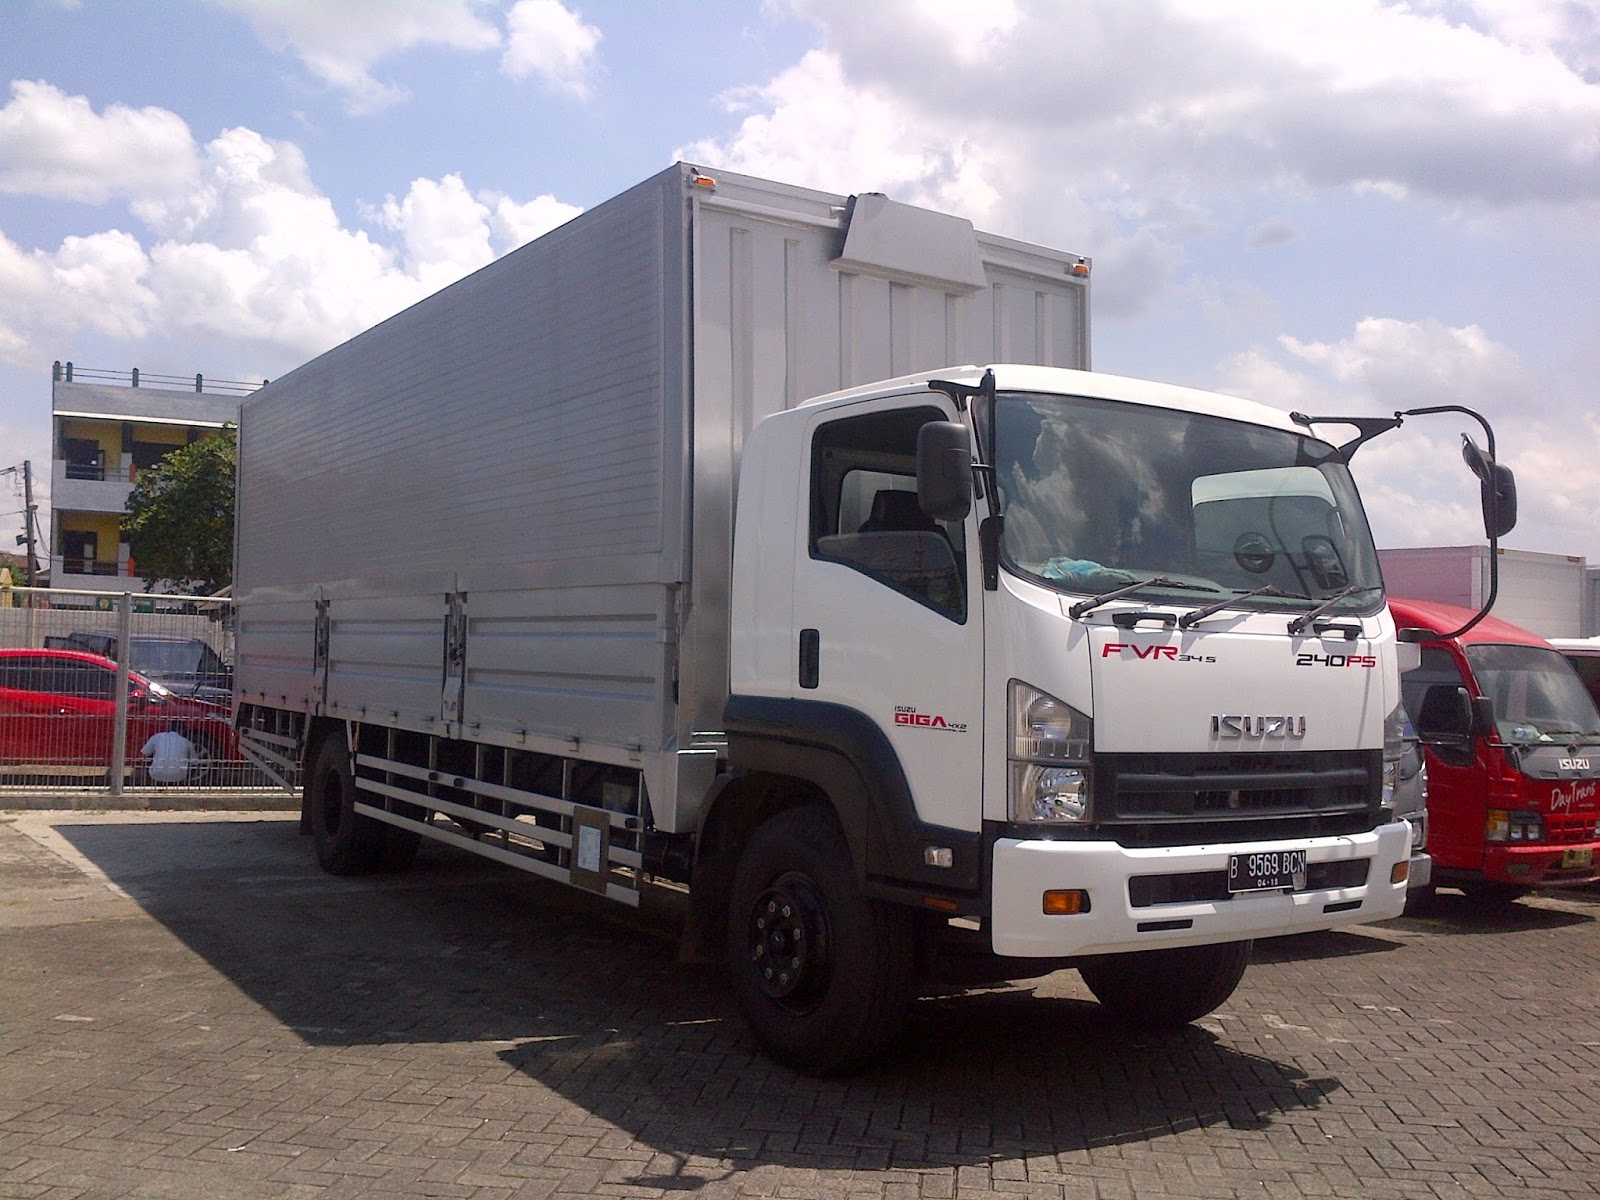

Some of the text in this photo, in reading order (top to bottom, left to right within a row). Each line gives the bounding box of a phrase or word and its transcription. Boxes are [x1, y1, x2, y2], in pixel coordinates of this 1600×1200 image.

[1102, 643, 1178, 660] FVR
[1296, 653, 1377, 668] 240PS
[895, 713, 947, 727] GIGA
[1211, 714, 1306, 740] ISUZU
[1558, 758, 1590, 770] ISUZU
[1230, 851, 1305, 879] B 9569 BCN
